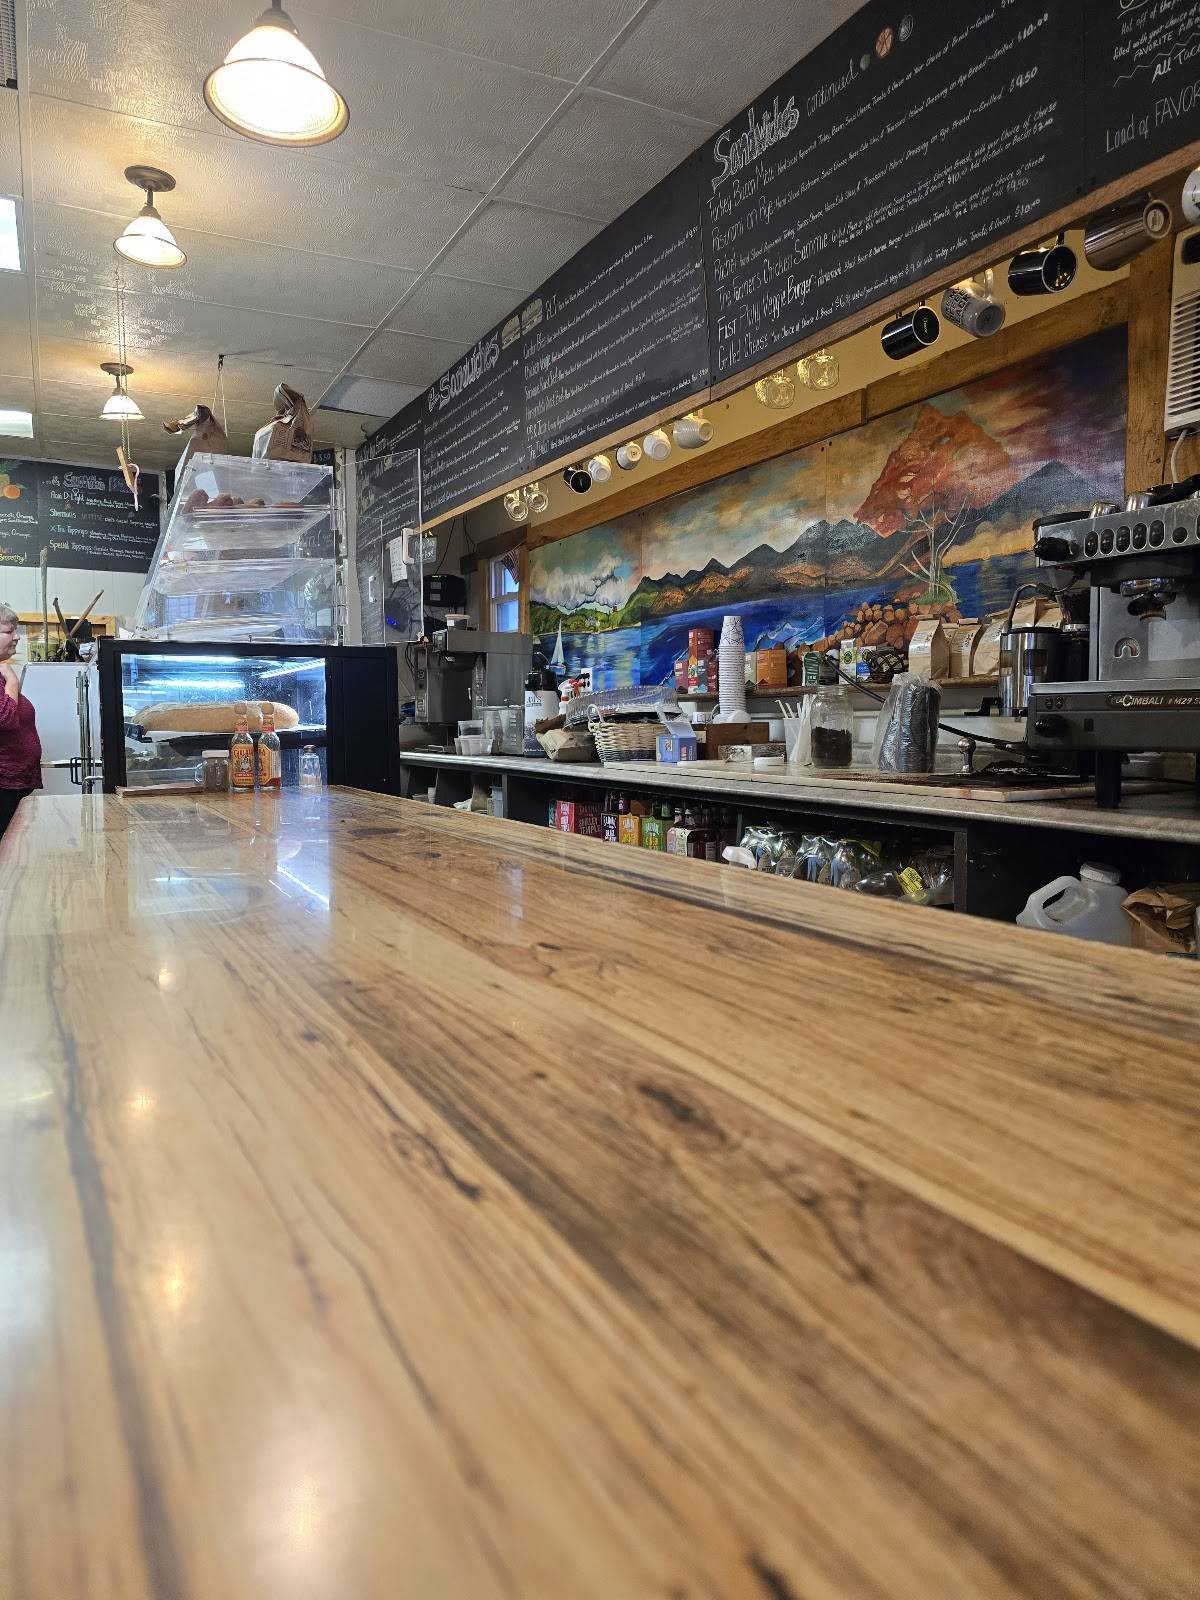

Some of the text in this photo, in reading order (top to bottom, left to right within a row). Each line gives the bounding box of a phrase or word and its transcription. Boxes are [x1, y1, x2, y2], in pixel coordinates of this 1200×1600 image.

[1112, 40, 1132, 61] filled
[1132, 32, 1148, 50] with
[1149, 23, 1165, 41] your
[1165, 13, 1188, 29] choice
[1188, 2, 1198, 17] of
[1121, 17, 1134, 35] Hot
[1136, 11, 1148, 28] off
[1150, 3, 1158, 19] of
[1133, 30, 1174, 62] FAVORITE
[1009, 66, 1037, 92] $9.50
[1151, 56, 1172, 84] All
[711, 59, 857, 193] Sandwiches continued
[1138, 115, 1150, 140] of
[706, 192, 732, 222] Turkey
[732, 178, 756, 206] Bacon
[762, 255, 792, 283] Chicken
